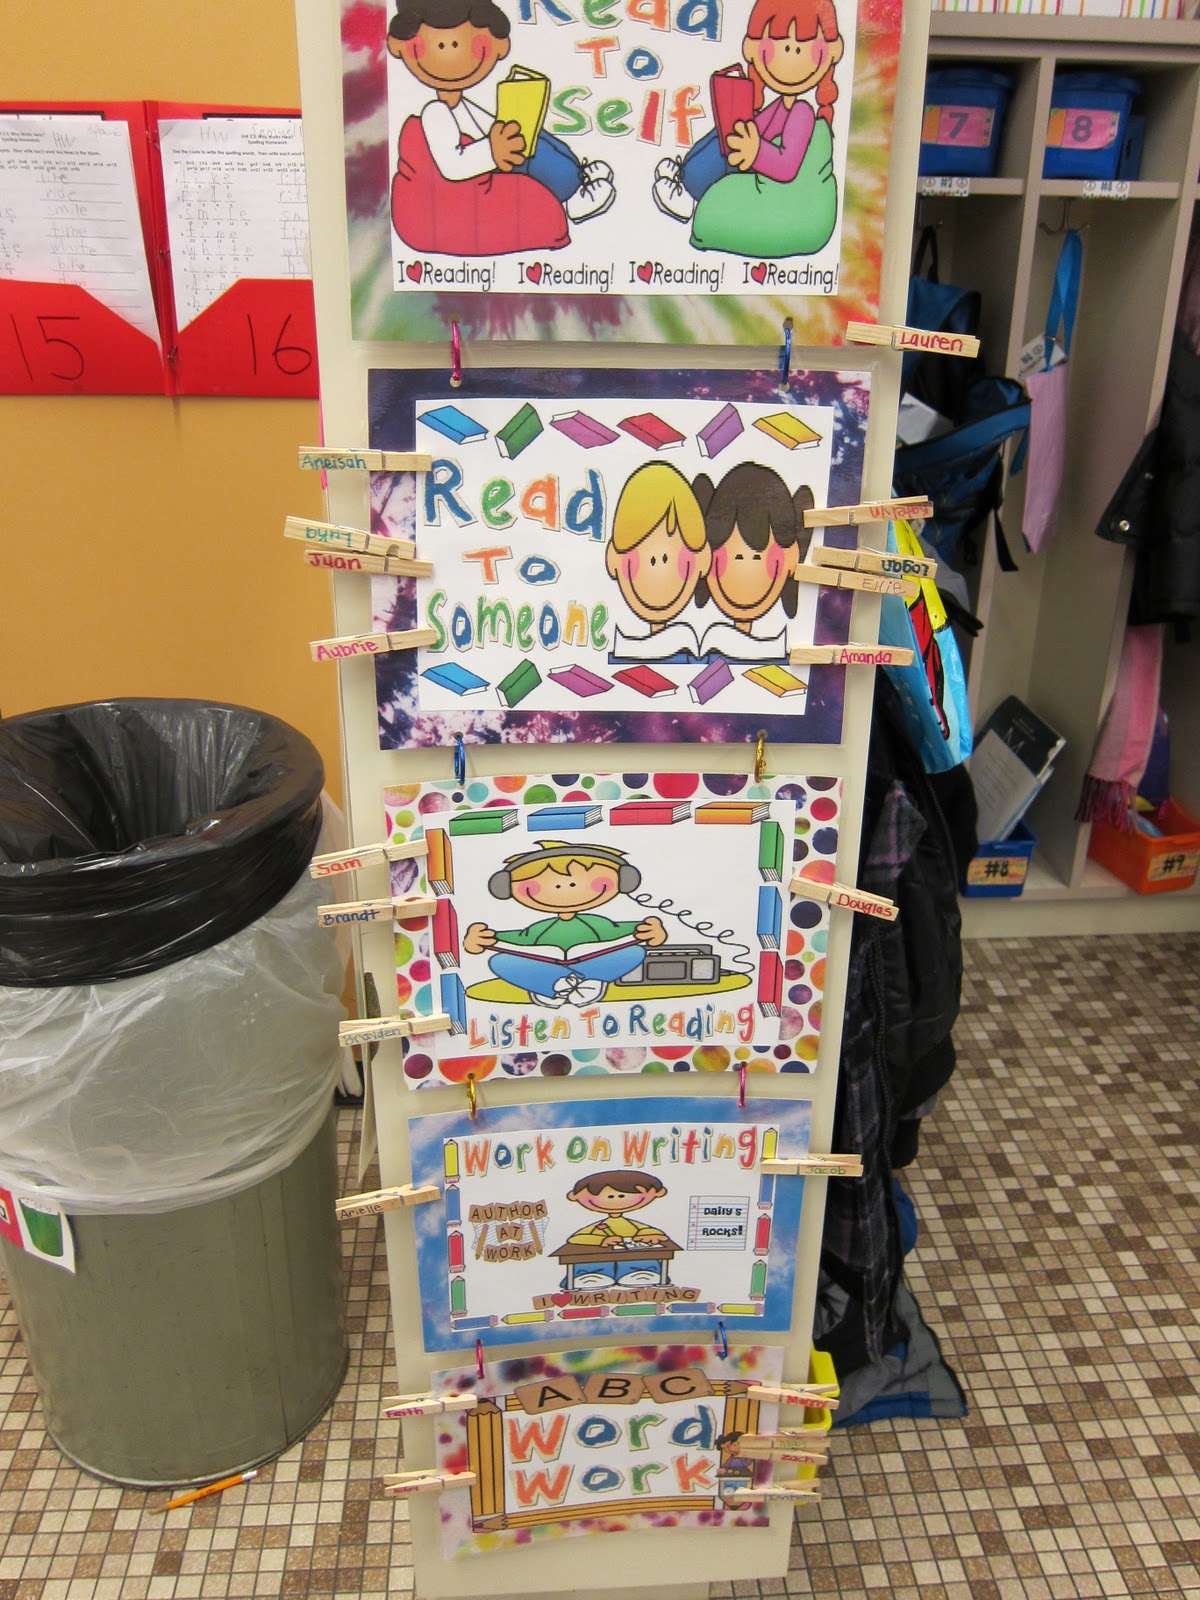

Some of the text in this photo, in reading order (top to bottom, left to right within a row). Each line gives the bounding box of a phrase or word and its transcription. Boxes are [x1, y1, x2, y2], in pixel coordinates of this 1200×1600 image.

[576, 37, 662, 80] To
[551, 86, 704, 147] Self
[949, 112, 969, 139] 7
[200, 125, 229, 142] HW
[1071, 115, 1093, 142] 8
[397, 260, 496, 292] I Reading!
[517, 261, 615, 293] I Reading!
[629, 260, 725, 293] I Reading!
[743, 261, 840, 294] I Reading!
[10, 313, 84, 381] 15
[247, 313, 312, 375] 16
[900, 332, 964, 352] Lauren
[424, 457, 607, 542] Read
[308, 553, 362, 570] Juan
[463, 547, 561, 585] To
[881, 559, 930, 577] Logan
[427, 589, 609, 652] Someone
[316, 640, 379, 661] Aubrie
[839, 648, 893, 665] Amanda
[317, 858, 362, 876] Sam
[984, 861, 1010, 878] #8
[1162, 855, 1186, 873] #9
[837, 893, 893, 915] Douglas
[323, 910, 380, 926] Brandt
[469, 1002, 756, 1048] Listen To Reading
[463, 1136, 555, 1177] Work
[623, 1126, 758, 1169] Writing
[804, 1165, 846, 1175] Jacob
[340, 1205, 382, 1219] Arielle
[471, 1203, 546, 1219] AUTHOR
[735, 1208, 742, 1216] 5
[500, 1226, 521, 1239] AT
[486, 1245, 533, 1260] WORK
[573, 1290, 696, 1305] WRITING
[385, 1407, 424, 1418] Faith
[508, 1404, 717, 1463] Word
[511, 1454, 717, 1507] Work
